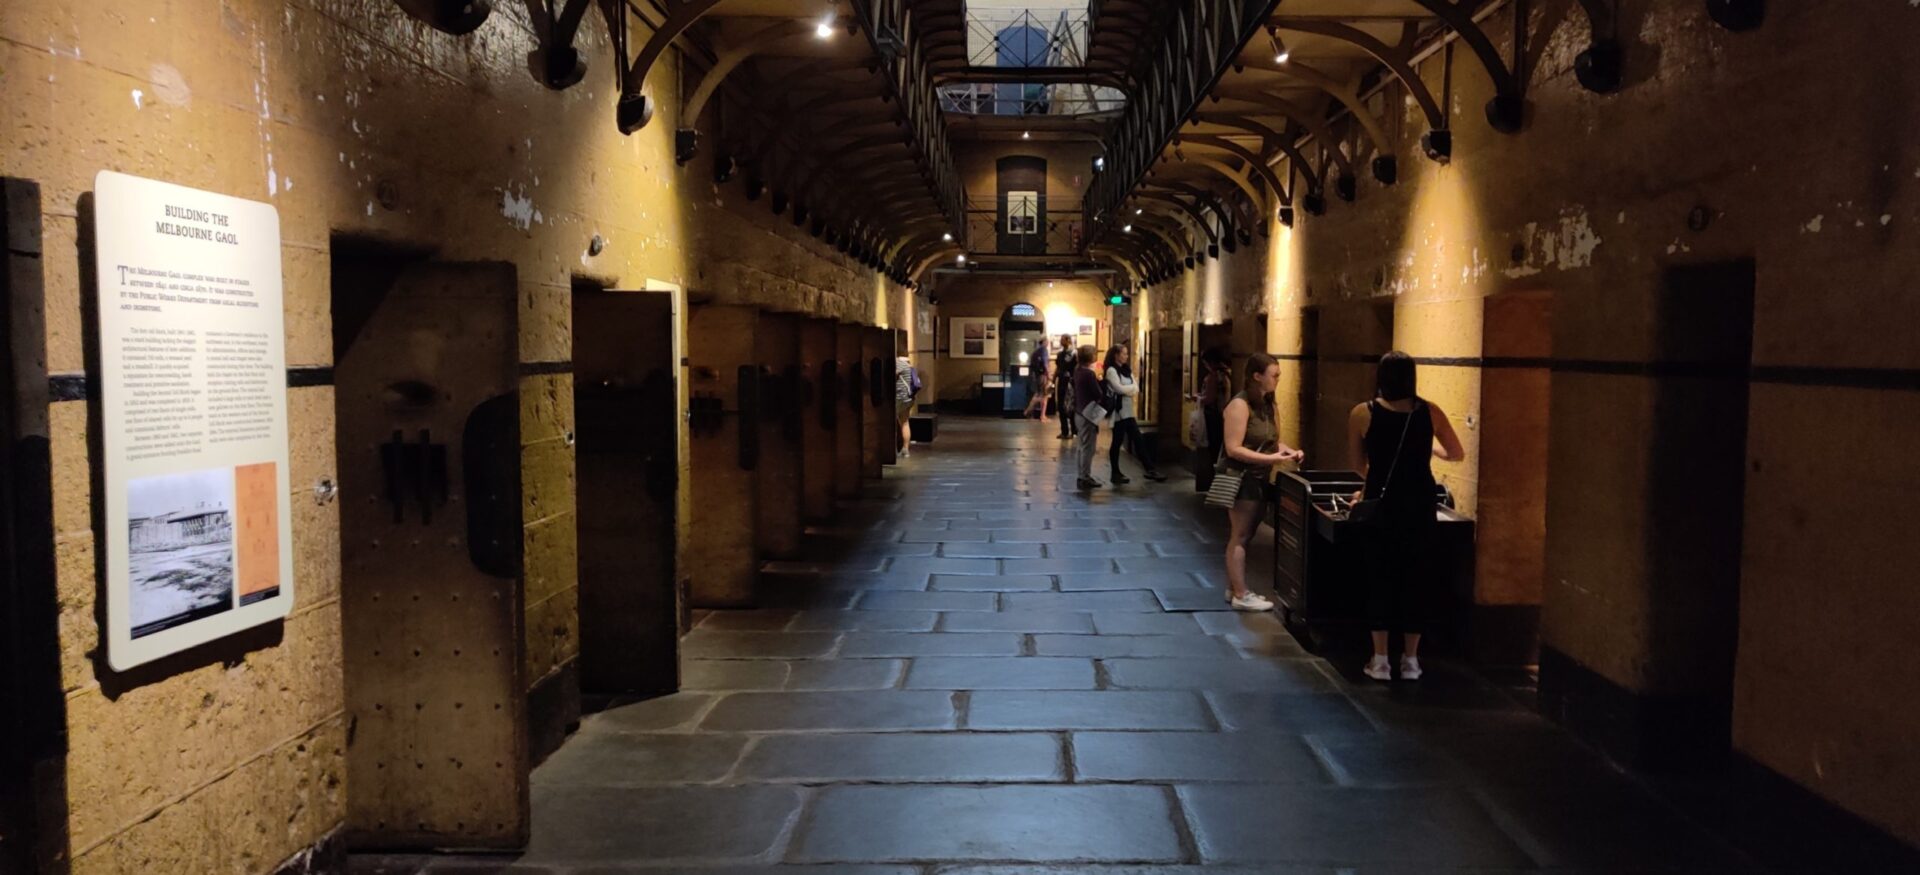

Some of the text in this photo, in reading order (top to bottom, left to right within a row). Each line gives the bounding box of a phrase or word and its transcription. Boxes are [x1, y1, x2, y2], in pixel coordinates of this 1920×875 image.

[165, 204, 228, 226] BUILDING THE
[156, 222, 238, 245] MELBOURNE GAOL
